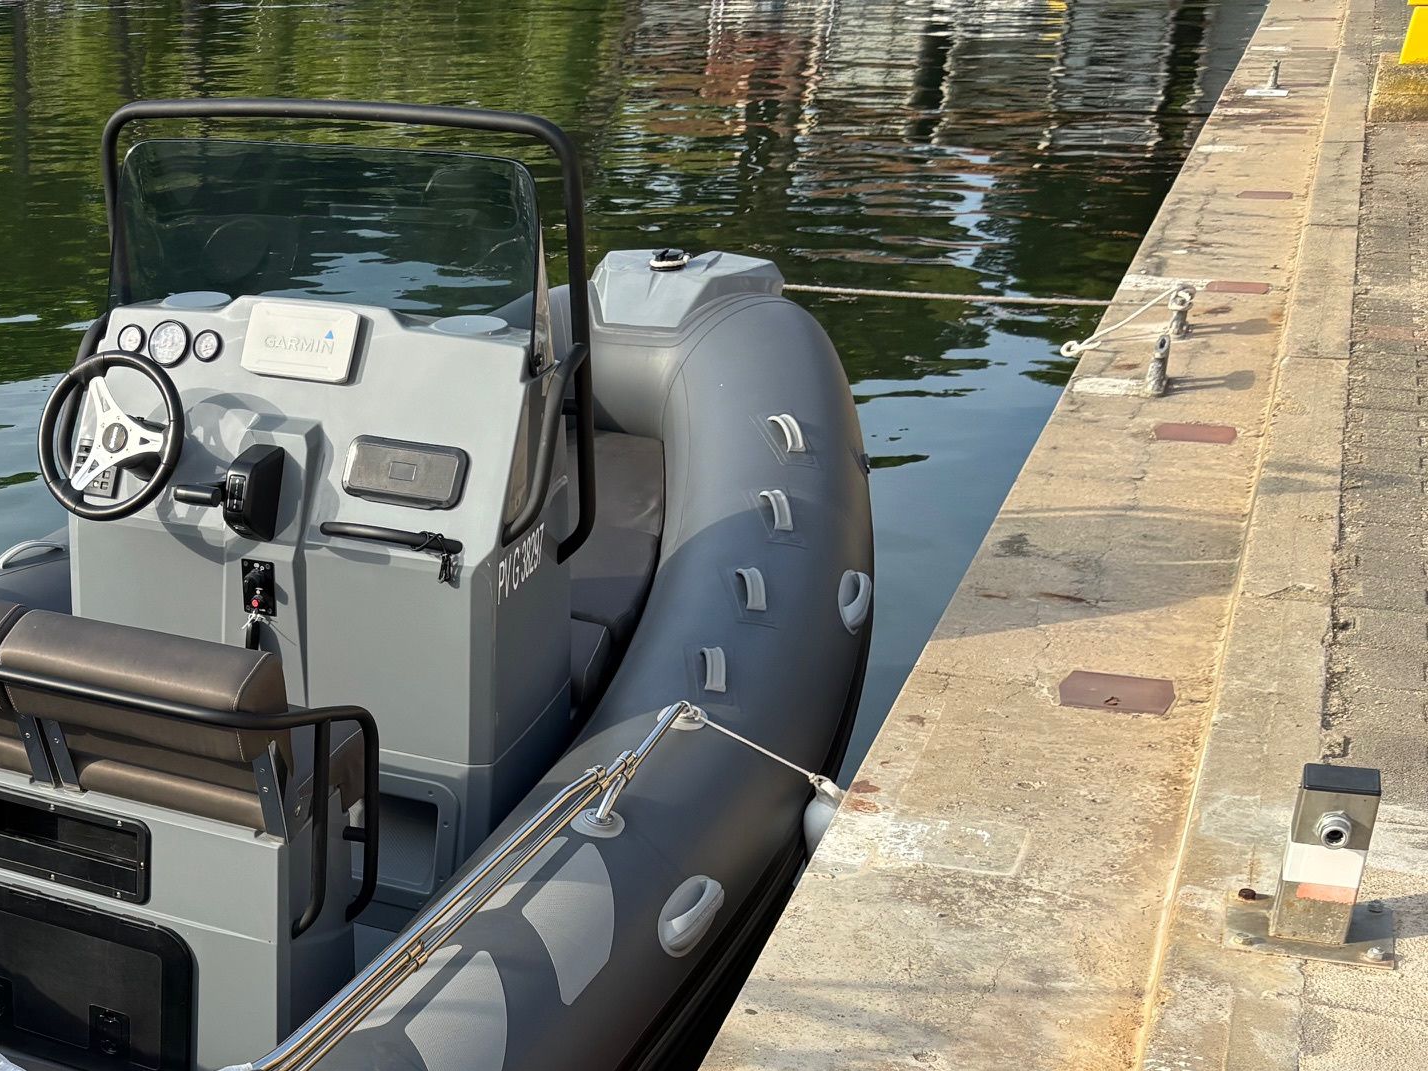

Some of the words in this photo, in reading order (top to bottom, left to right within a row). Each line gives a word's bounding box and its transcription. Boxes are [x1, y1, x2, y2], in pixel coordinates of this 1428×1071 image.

[264, 333, 336, 355] GARMIN
[497, 553, 512, 606] PV
[520, 521, 545, 583] 38297
